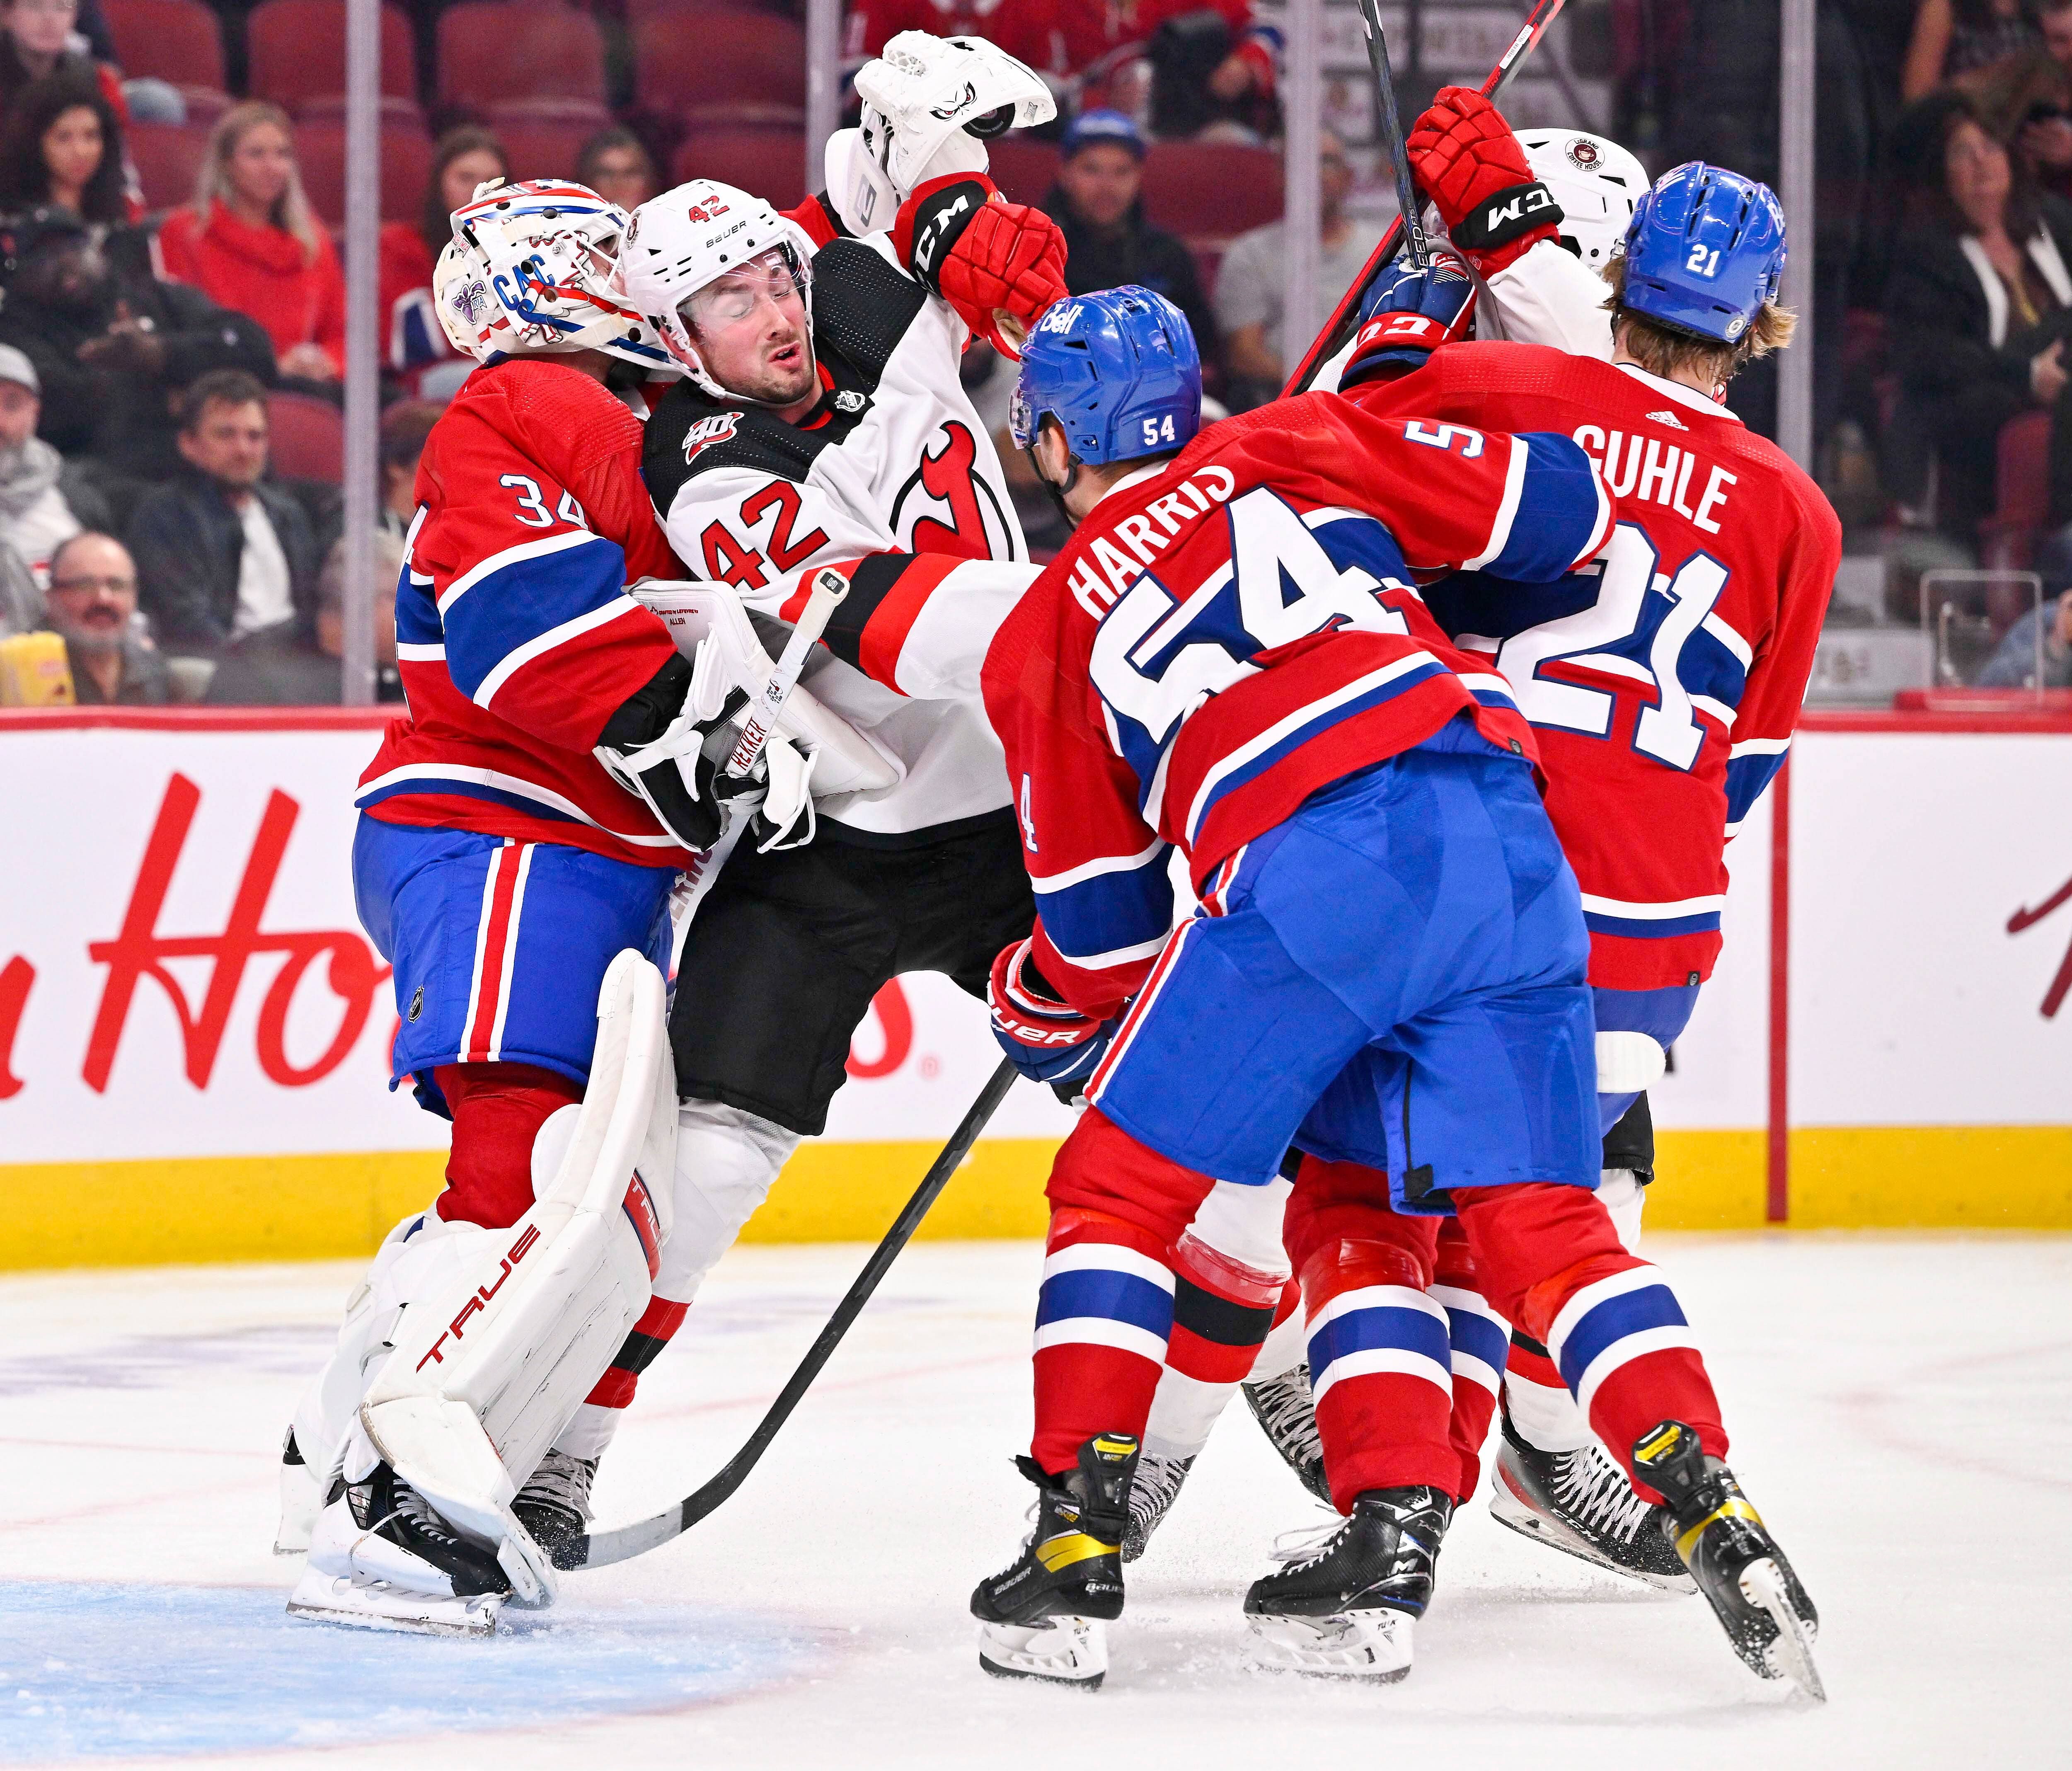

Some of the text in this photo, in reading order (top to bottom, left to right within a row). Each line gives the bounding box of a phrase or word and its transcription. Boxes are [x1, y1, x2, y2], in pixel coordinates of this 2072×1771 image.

[1567, 152, 1602, 170] COFFEE HOUSE
[688, 195, 730, 223] 42
[1488, 189, 1556, 232] CM
[1686, 244, 1720, 277] 21
[1143, 414, 1176, 446] 54
[1645, 413, 1690, 431] adidas
[1573, 424, 1738, 534] GUHLE
[700, 479, 831, 591] 42
[670, 617, 686, 626] ALLEN
[1089, 482, 1410, 745] 54
[1495, 519, 1733, 773] 21
[731, 716, 767, 771] REKKER
[416, 1223, 541, 1374] TRUE
[1550, 1507, 1600, 1541] CCM
